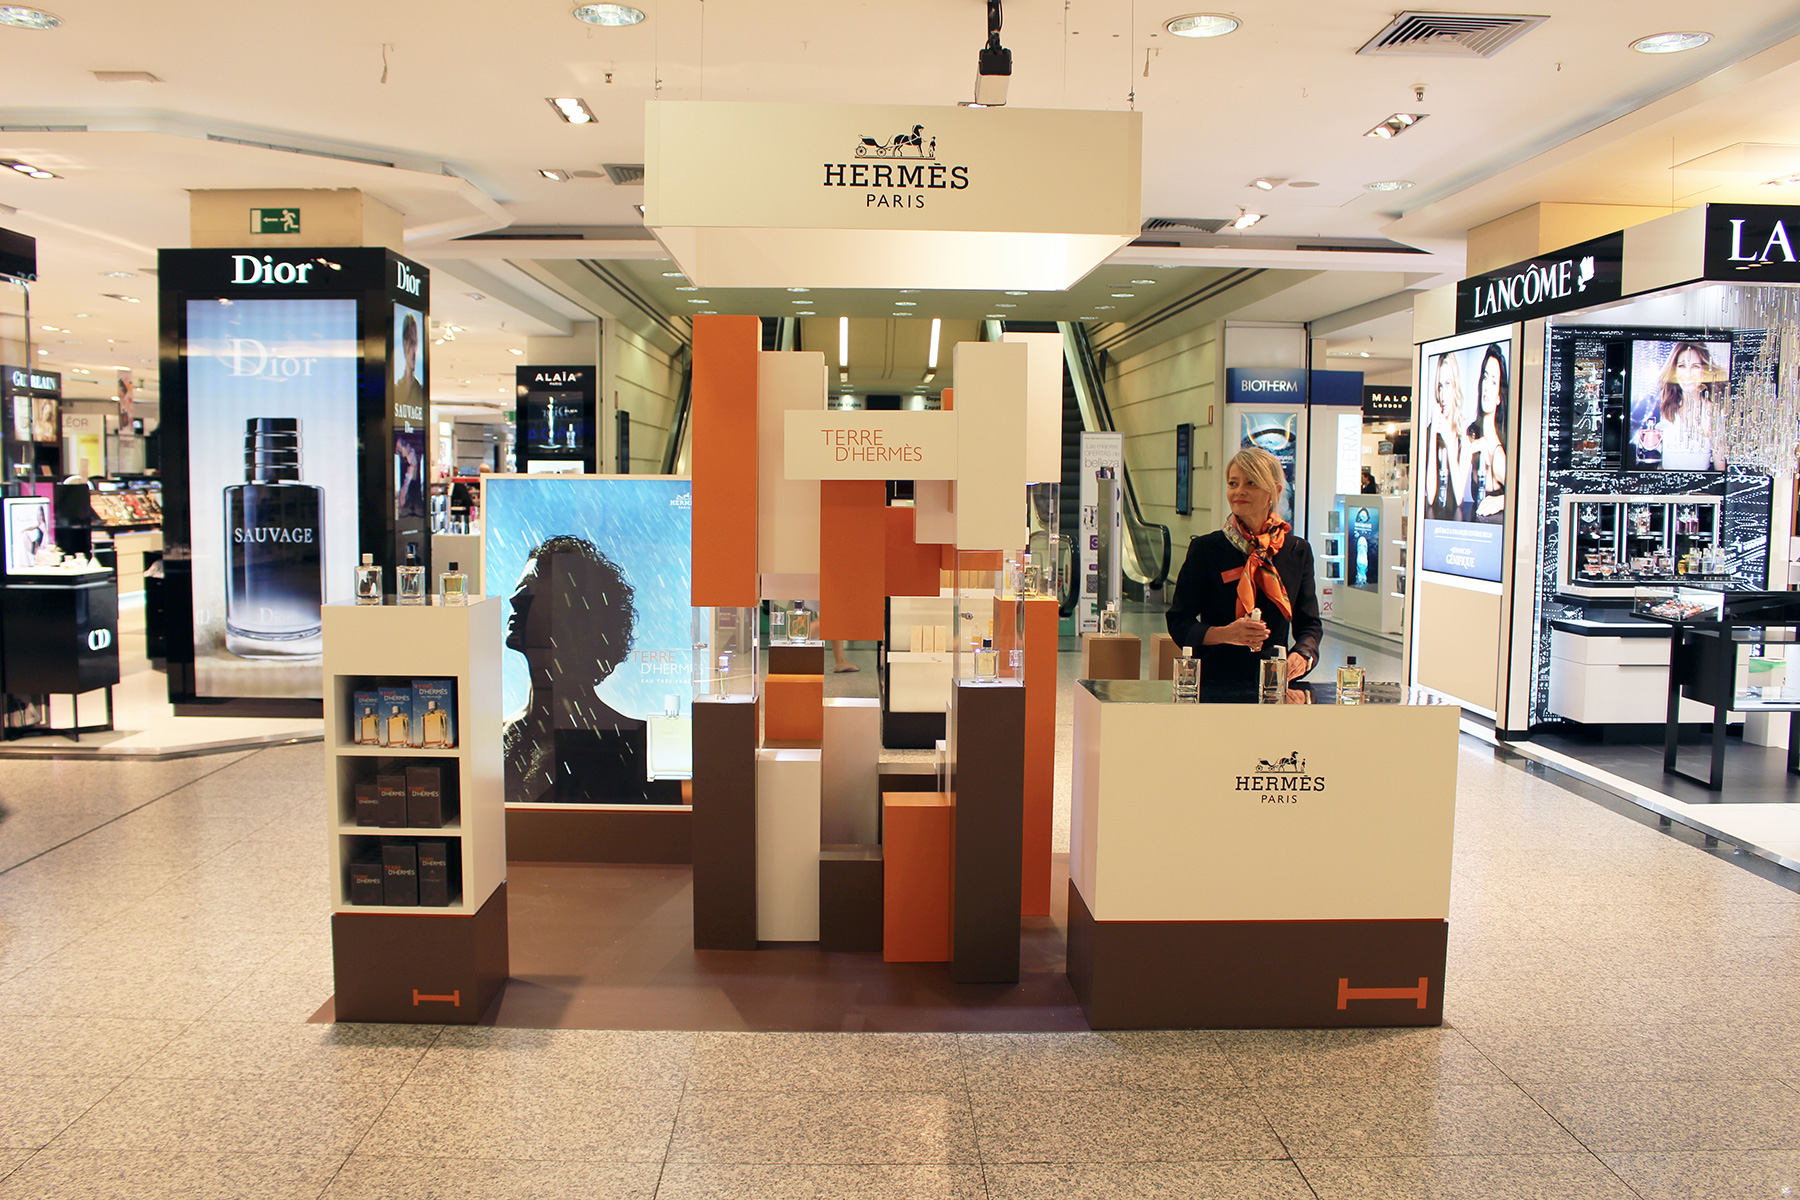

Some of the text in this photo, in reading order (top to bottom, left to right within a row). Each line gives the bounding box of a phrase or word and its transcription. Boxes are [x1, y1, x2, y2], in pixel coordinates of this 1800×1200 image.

[823, 162, 969, 190] HERMÈS
[866, 193, 925, 209] PARIS
[1726, 218, 1800, 263] LA
[230, 254, 313, 284] Dior
[396, 260, 421, 297] Dior
[1473, 258, 1574, 319] LANCÔME
[226, 337, 318, 378] Dior
[12, 370, 57, 391] GURLAIN
[534, 370, 577, 382] ALAÏA
[1240, 379, 1298, 393] BIOTHERM
[1372, 392, 1412, 402] MALO
[821, 429, 884, 446] TERRE
[835, 443, 923, 462] D'HERMÈS
[1084, 458, 1120, 468] belleza
[234, 527, 313, 543] SAUVAGE
[631, 650, 676, 663] TERRE
[1235, 774, 1326, 792] HERMÈS
[1261, 794, 1298, 804] PARIS
